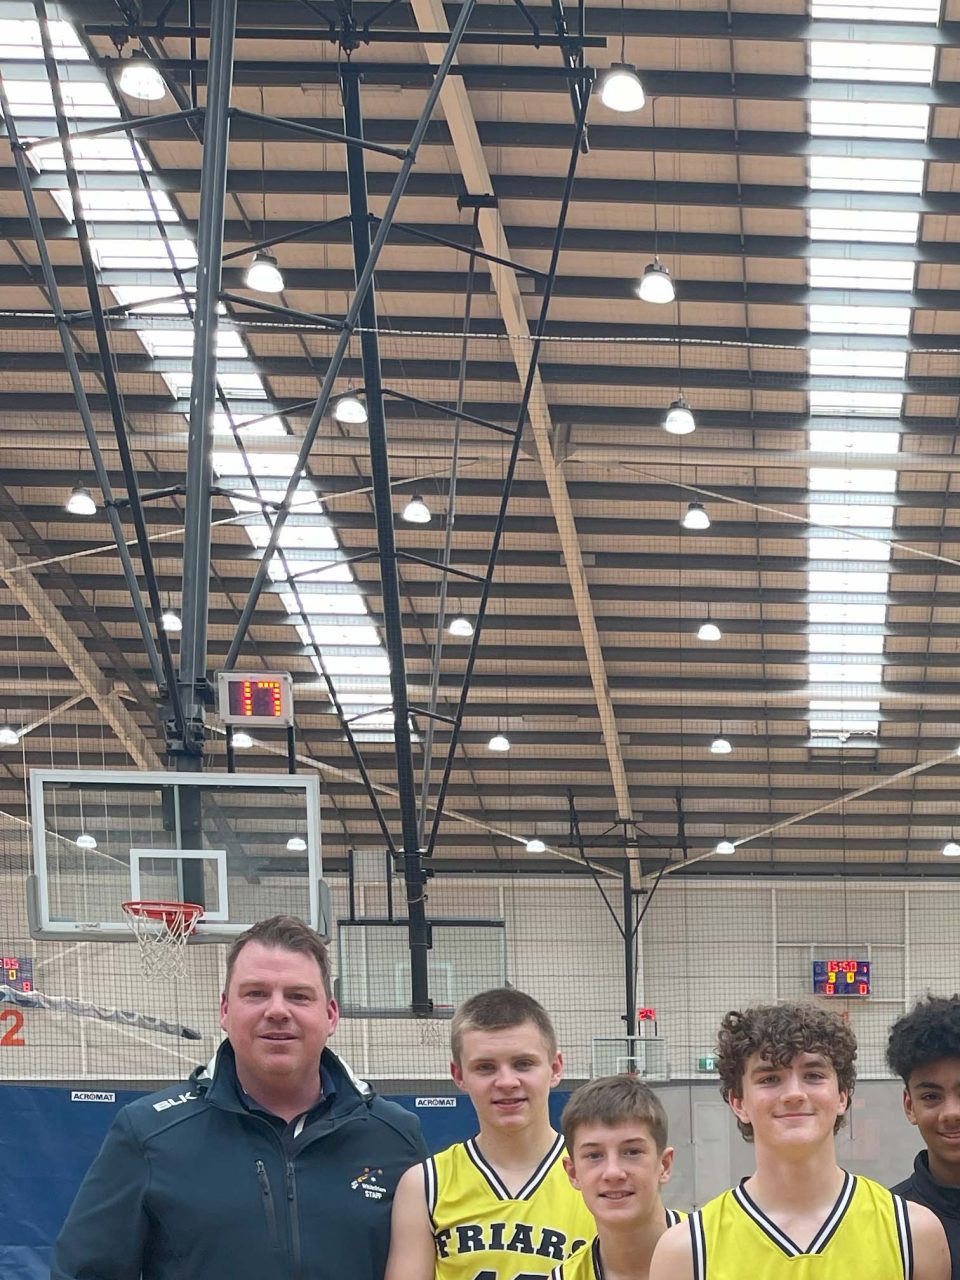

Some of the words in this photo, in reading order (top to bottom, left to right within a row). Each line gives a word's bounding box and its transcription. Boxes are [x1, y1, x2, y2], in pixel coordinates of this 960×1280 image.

[244, 681, 281, 717] 17
[827, 961, 857, 973] 15:50
[828, 972, 836, 983] 3
[0, 1009, 25, 1046] 2
[73, 1093, 114, 1101] ACROMAT
[153, 1092, 197, 1112] BLK
